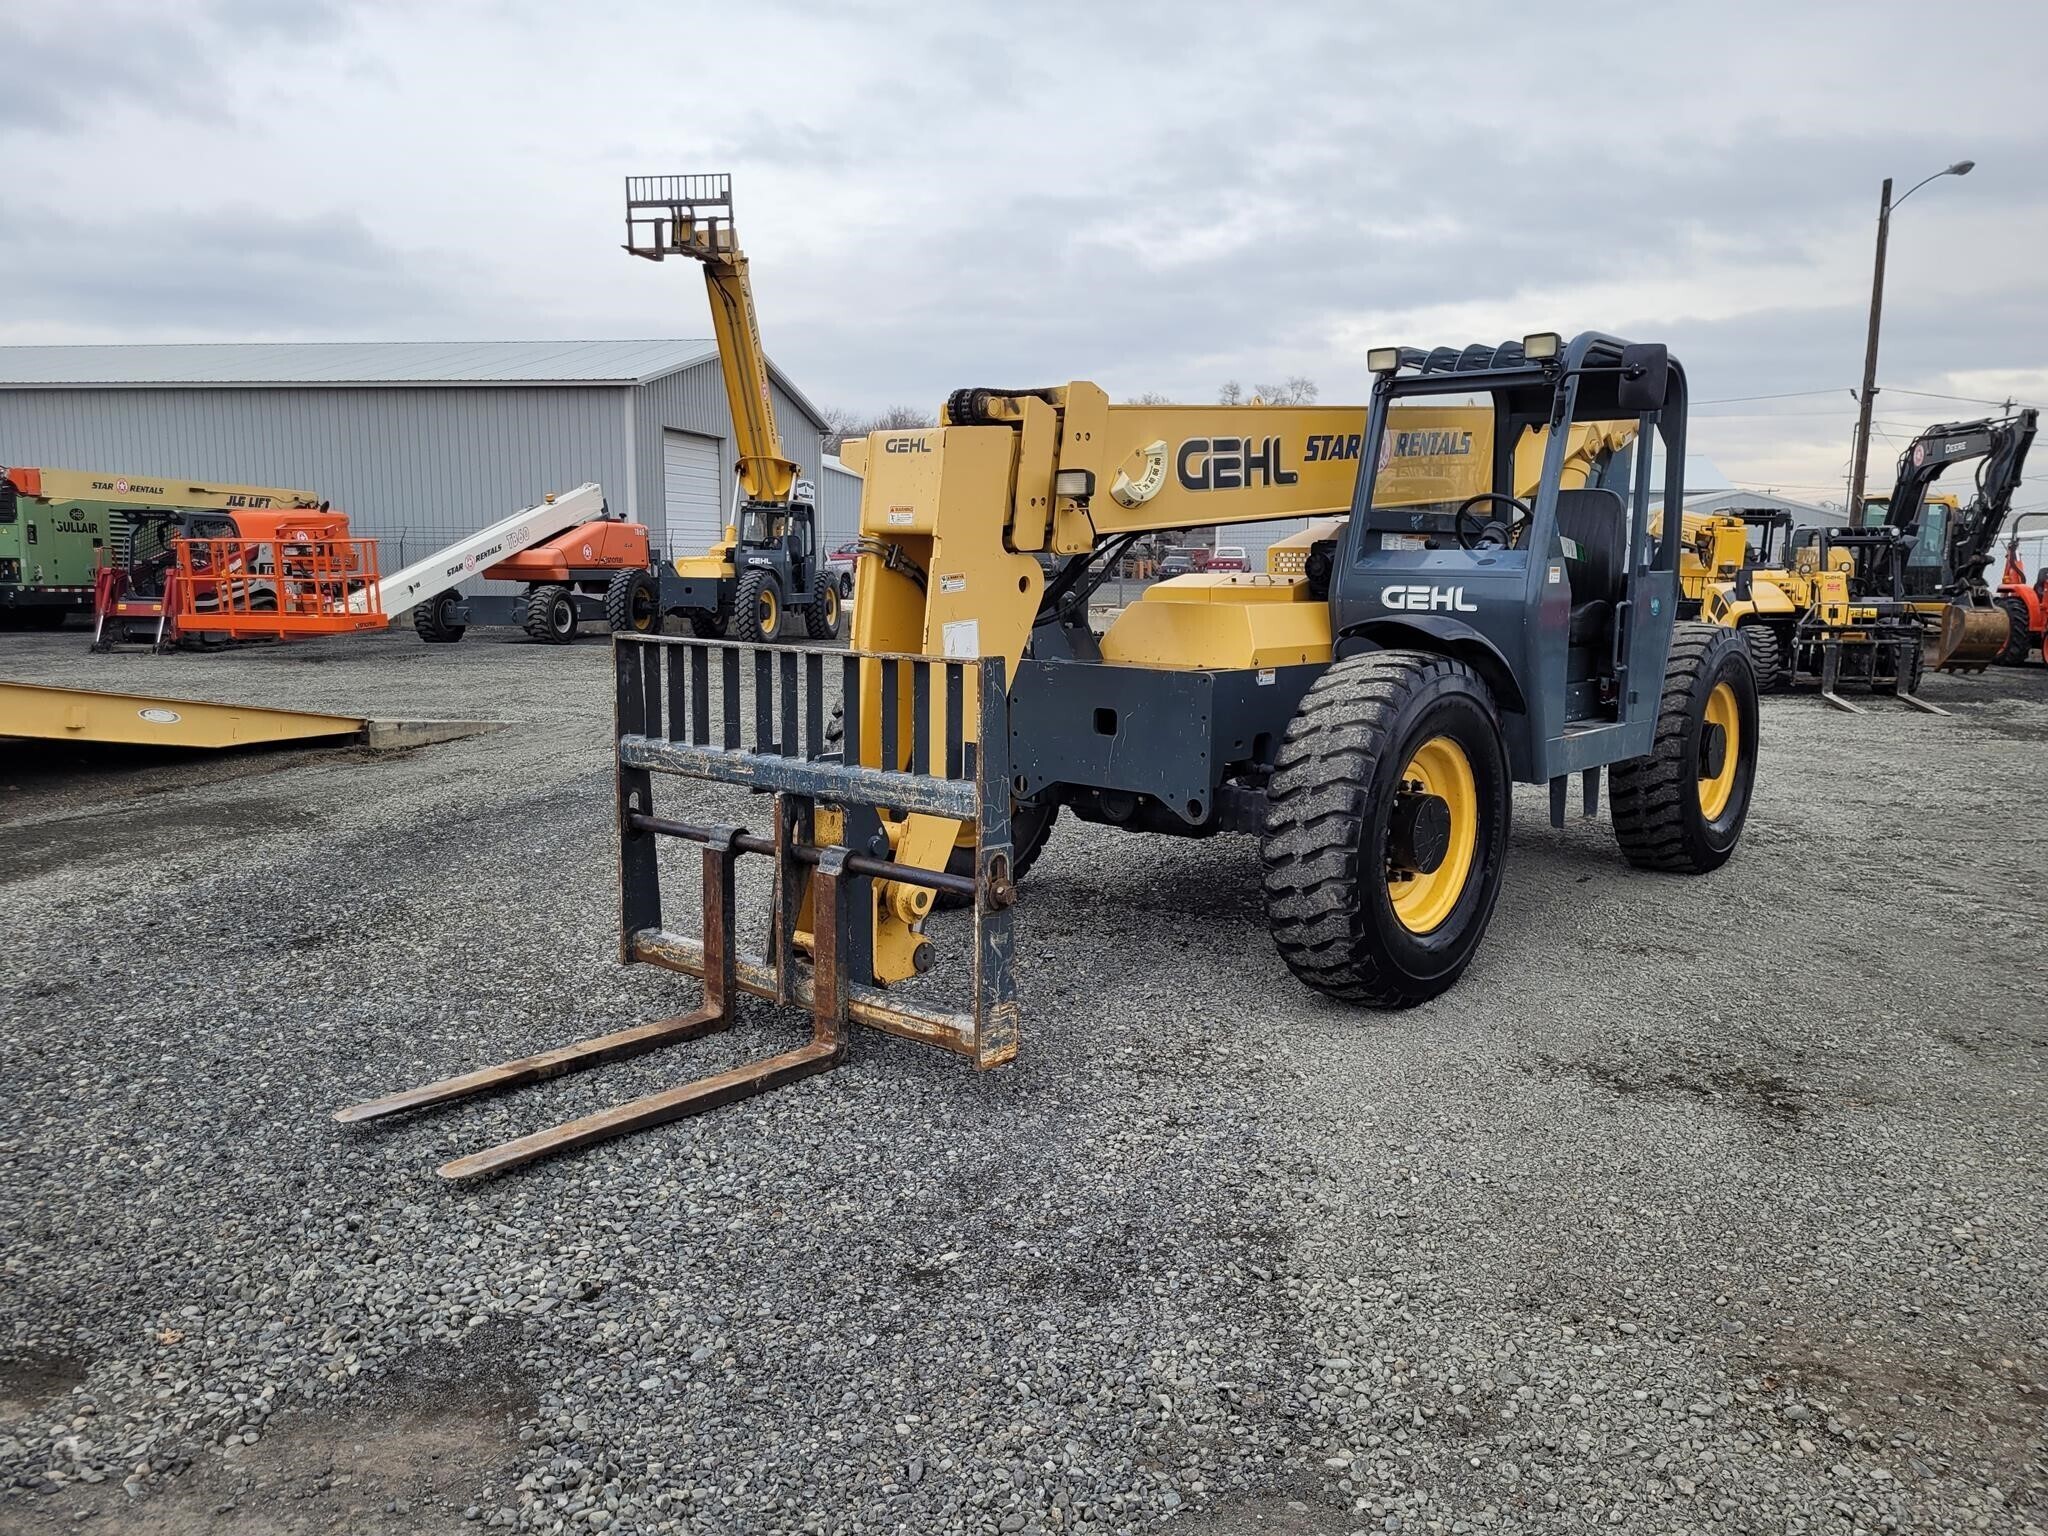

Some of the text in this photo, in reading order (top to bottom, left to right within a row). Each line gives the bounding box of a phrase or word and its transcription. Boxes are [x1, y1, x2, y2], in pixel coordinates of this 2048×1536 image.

[885, 437, 932, 453] GEHL
[1303, 431, 1472, 461] STAR RENTALS
[1945, 441, 1967, 454] DEERE
[1177, 436, 1299, 492] GEHL
[92, 482, 164, 494] STAR RENTALS
[226, 495, 271, 508] JLG LIFT
[56, 521, 98, 533] SULLAIR
[505, 526, 530, 549] TB60
[446, 544, 502, 577] STAR RENTALS
[748, 557, 772, 565] GEHL
[1381, 585, 1478, 612] GEHL
